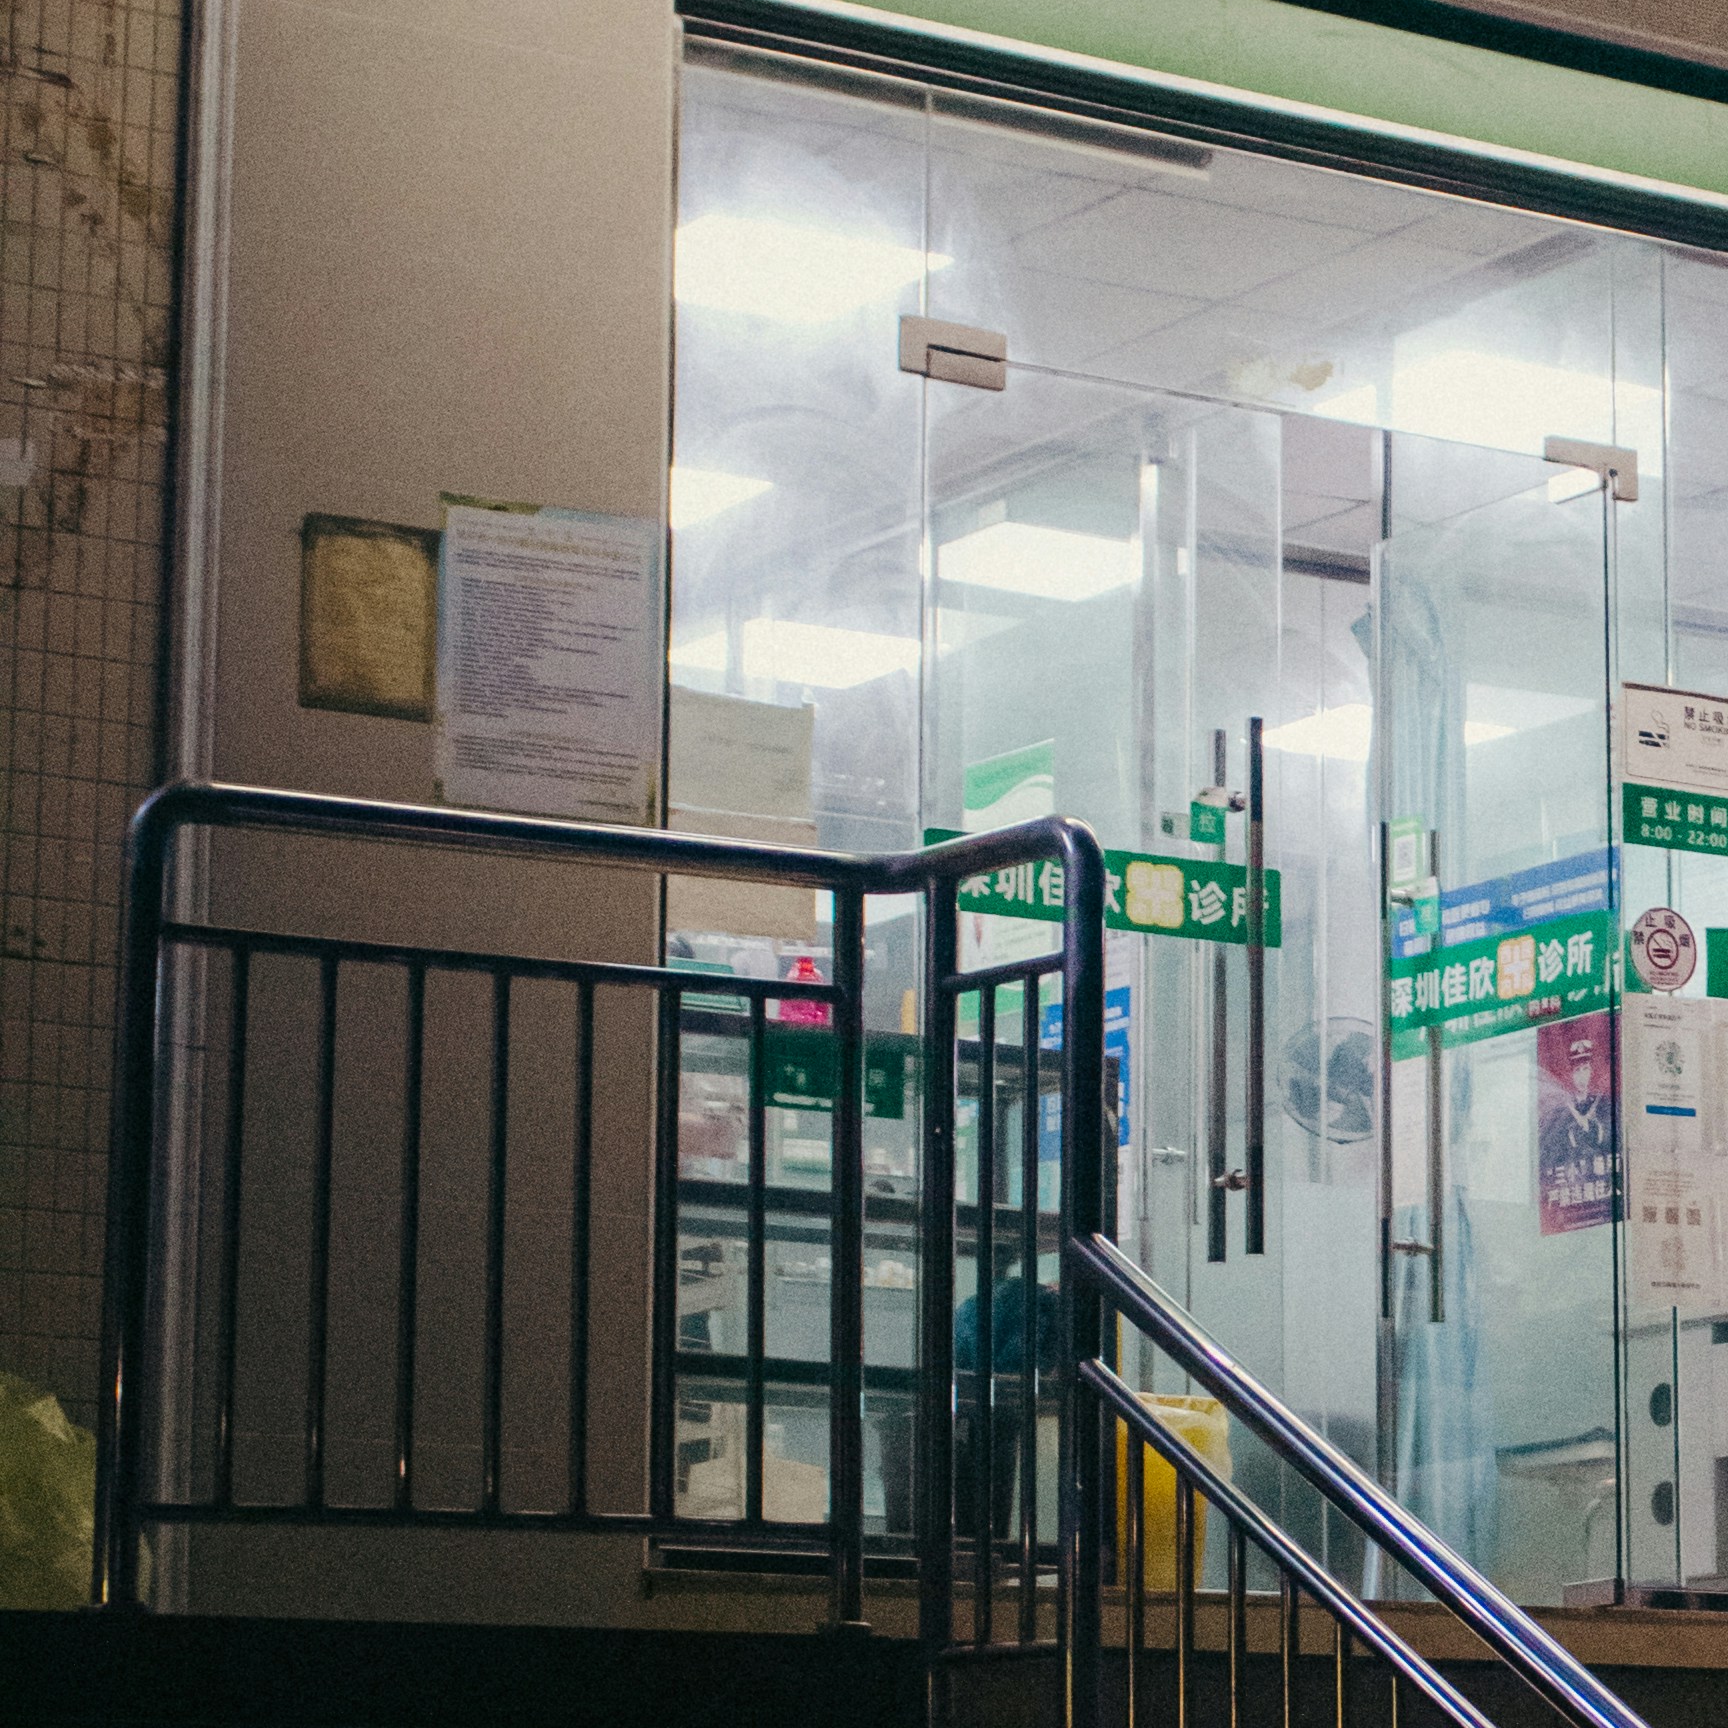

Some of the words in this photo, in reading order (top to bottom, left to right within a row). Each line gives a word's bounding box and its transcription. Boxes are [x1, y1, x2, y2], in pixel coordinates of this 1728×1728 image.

[1640, 796, 1728, 828] 营业时间
[1641, 823, 1673, 841] 8:00
[1687, 830, 1728, 849] 22:00
[1391, 956, 1495, 1018] 深圳佳欣
[1538, 930, 1594, 983] 诊所
